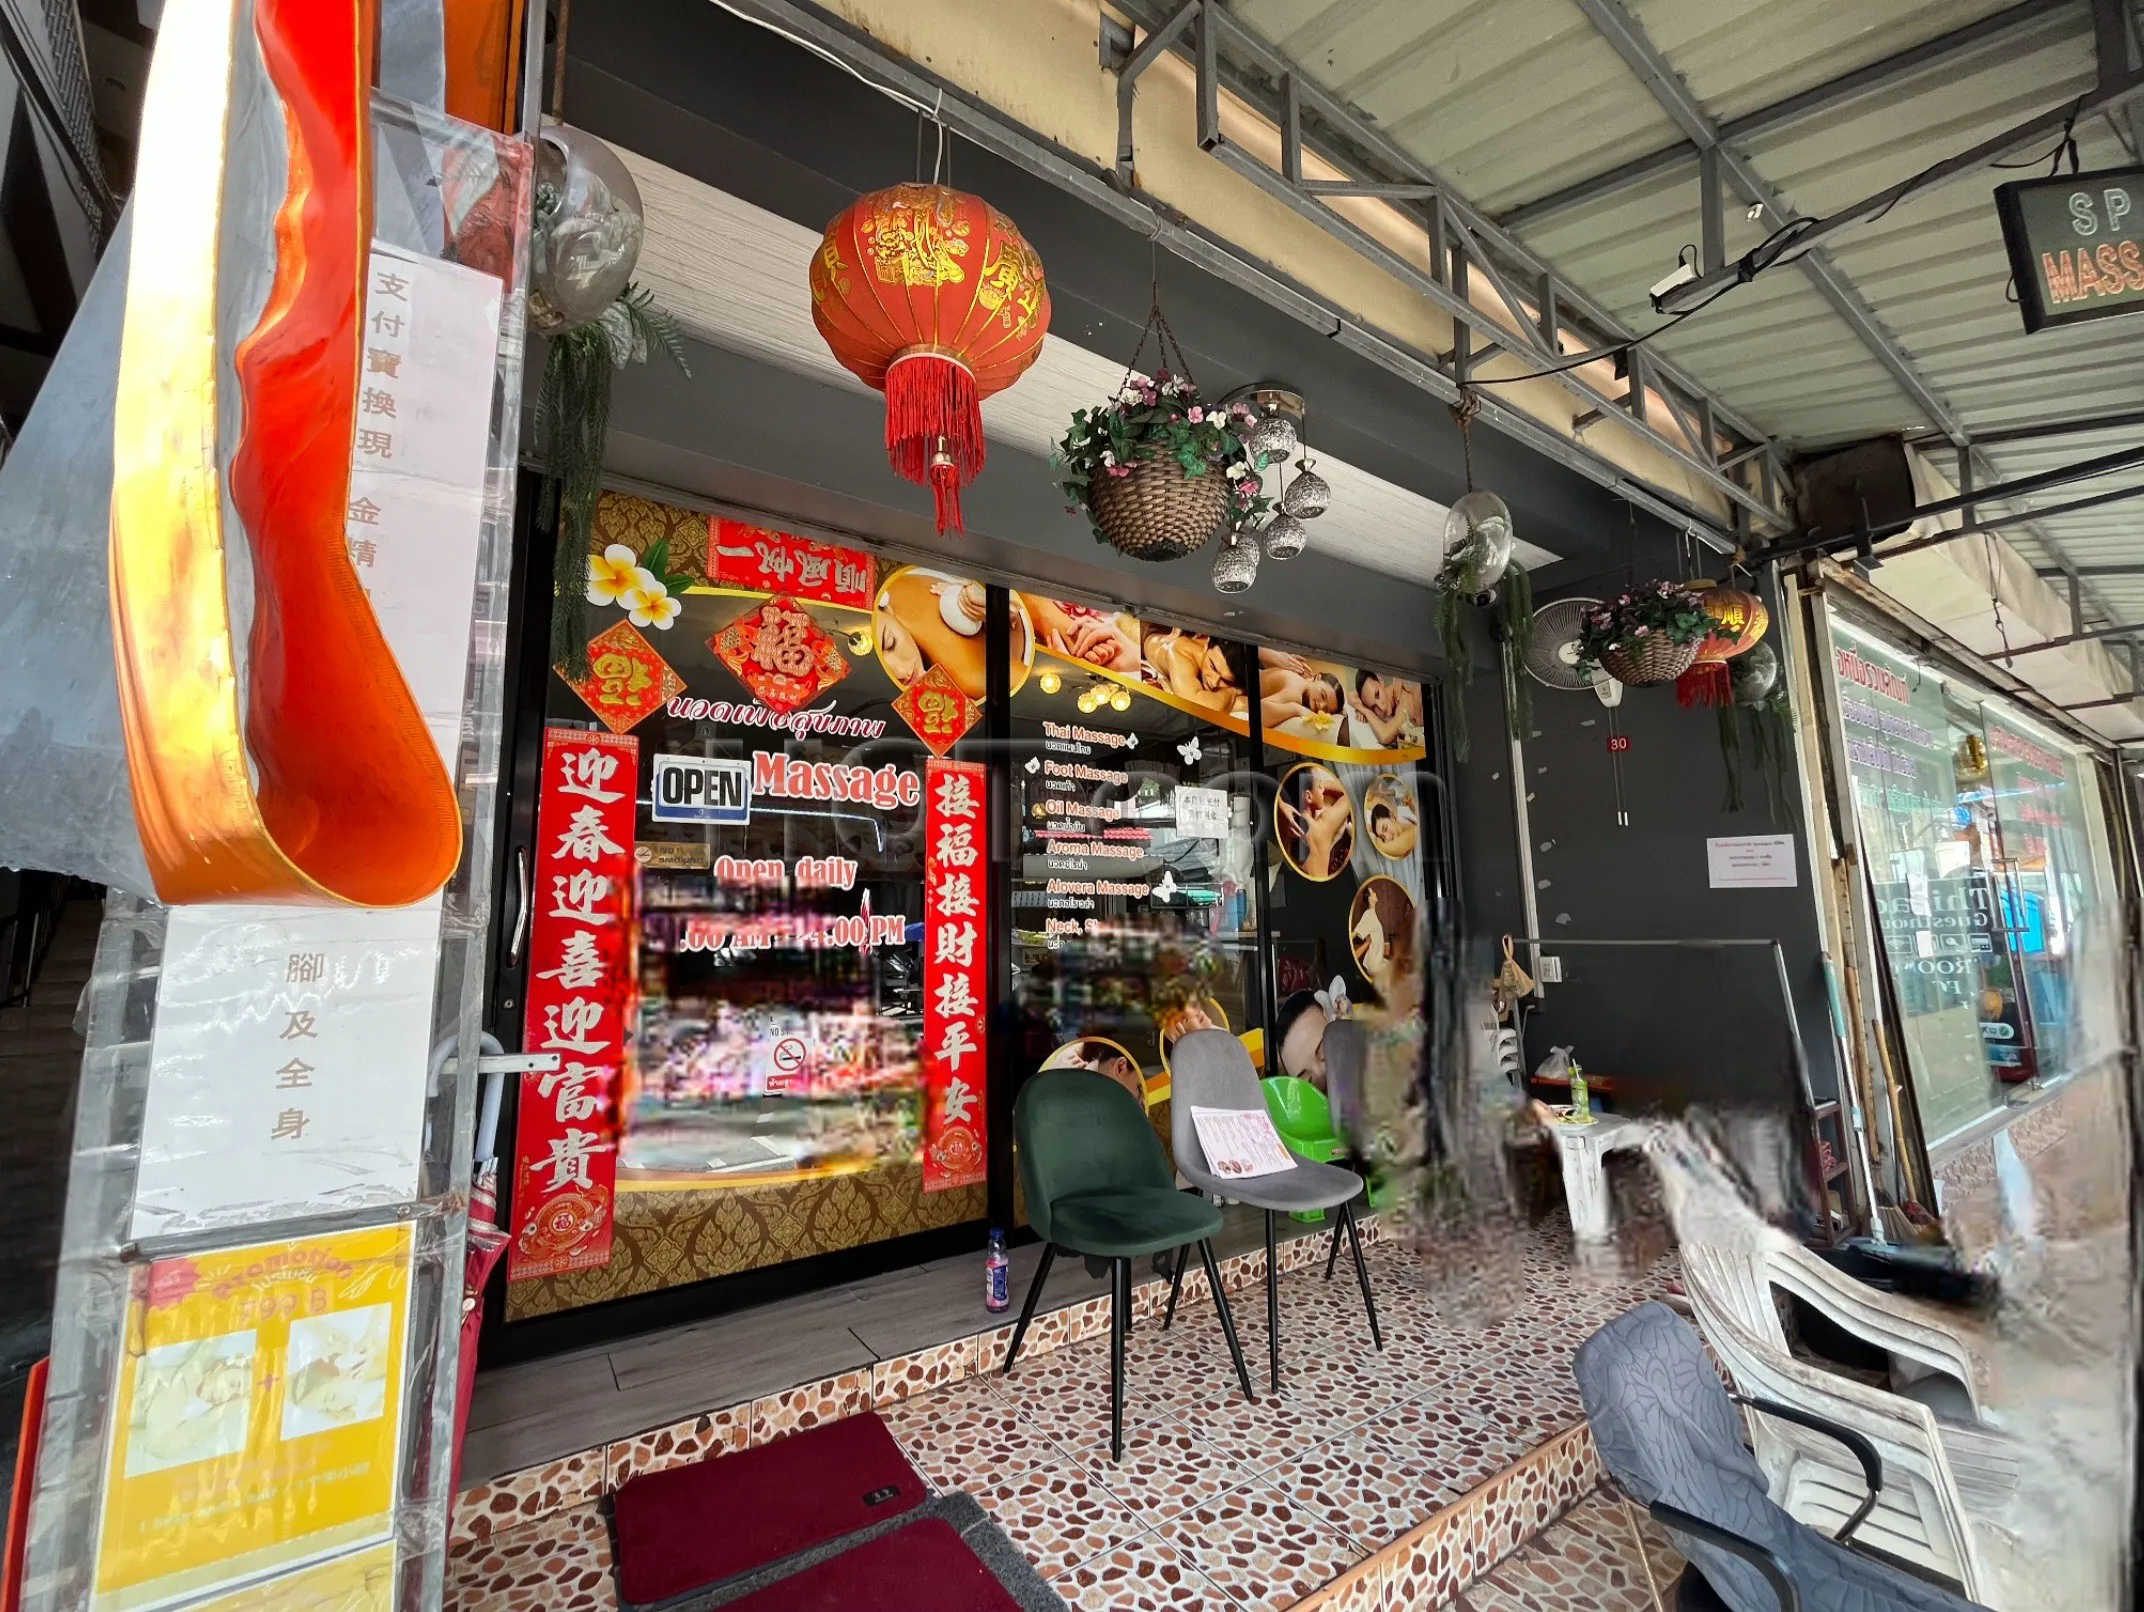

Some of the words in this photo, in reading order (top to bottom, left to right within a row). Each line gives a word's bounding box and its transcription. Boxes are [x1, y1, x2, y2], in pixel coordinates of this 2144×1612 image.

[751, 606, 815, 677] 福
[666, 696, 887, 740] นวดเพอสุขภาพ
[1042, 721, 1071, 739] Thai
[1071, 726, 1127, 748] Massage
[1611, 739, 1627, 750] 30
[663, 767, 742, 807] OPEN
[752, 750, 921, 810] Massage
[1044, 760, 1074, 778] Foot
[1074, 764, 1129, 786] Massage
[1045, 799, 1064, 816] Oil
[1065, 802, 1121, 822] Massage
[1046, 838, 1090, 856] Aroma
[1090, 841, 1145, 861] Massage
[714, 854, 785, 886] Open
[794, 855, 858, 891] daily
[1047, 878, 1096, 895] Alovera
[1096, 879, 1150, 899] Massage
[870, 915, 906, 946] PM
[934, 773, 985, 1125] 接福接財接平安
[530, 750, 627, 1193] 迎春迎喜迎富貴
[271, 952, 325, 1139] 腳及全身
